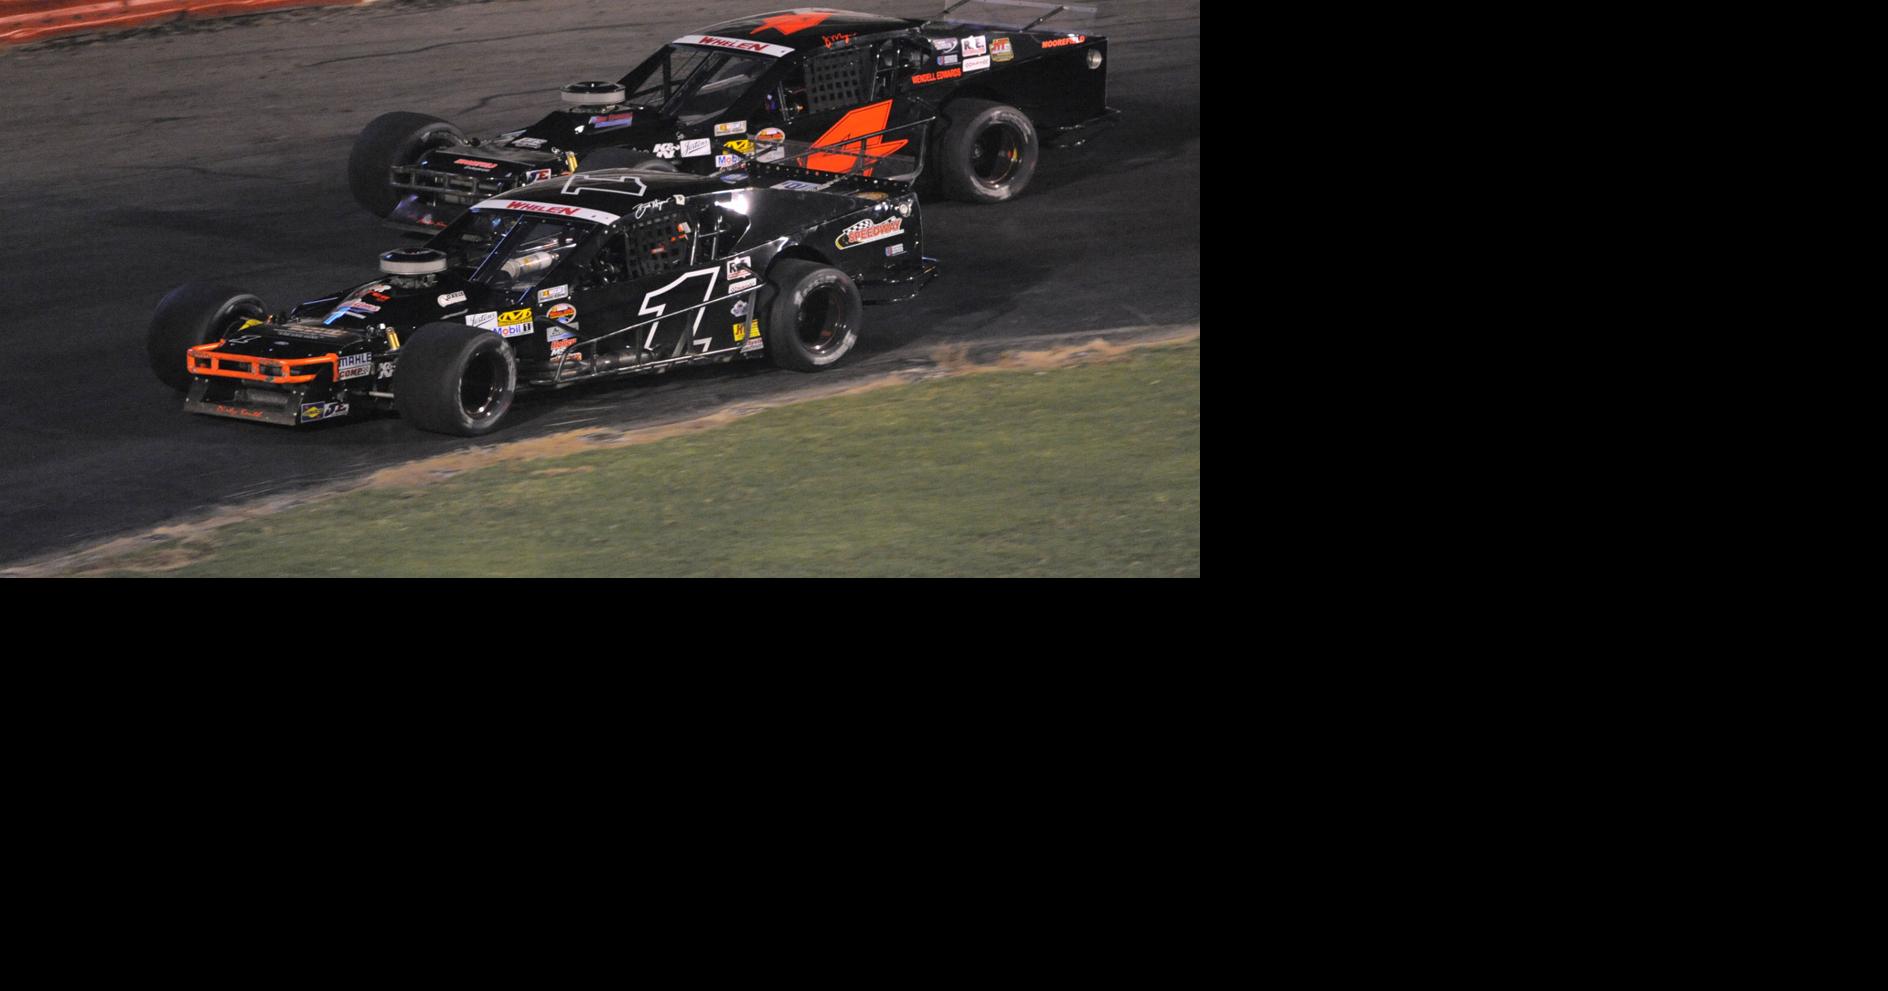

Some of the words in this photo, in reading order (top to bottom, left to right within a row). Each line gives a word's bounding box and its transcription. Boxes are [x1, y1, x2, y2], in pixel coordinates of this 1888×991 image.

[699, 36, 769, 51] WHELEN
[506, 201, 580, 216] WHELEN
[848, 217, 902, 243] SPEEDWAY
[638, 266, 720, 353] 1
[491, 324, 521, 336] Mobil
[341, 352, 372, 368] MAHLE
